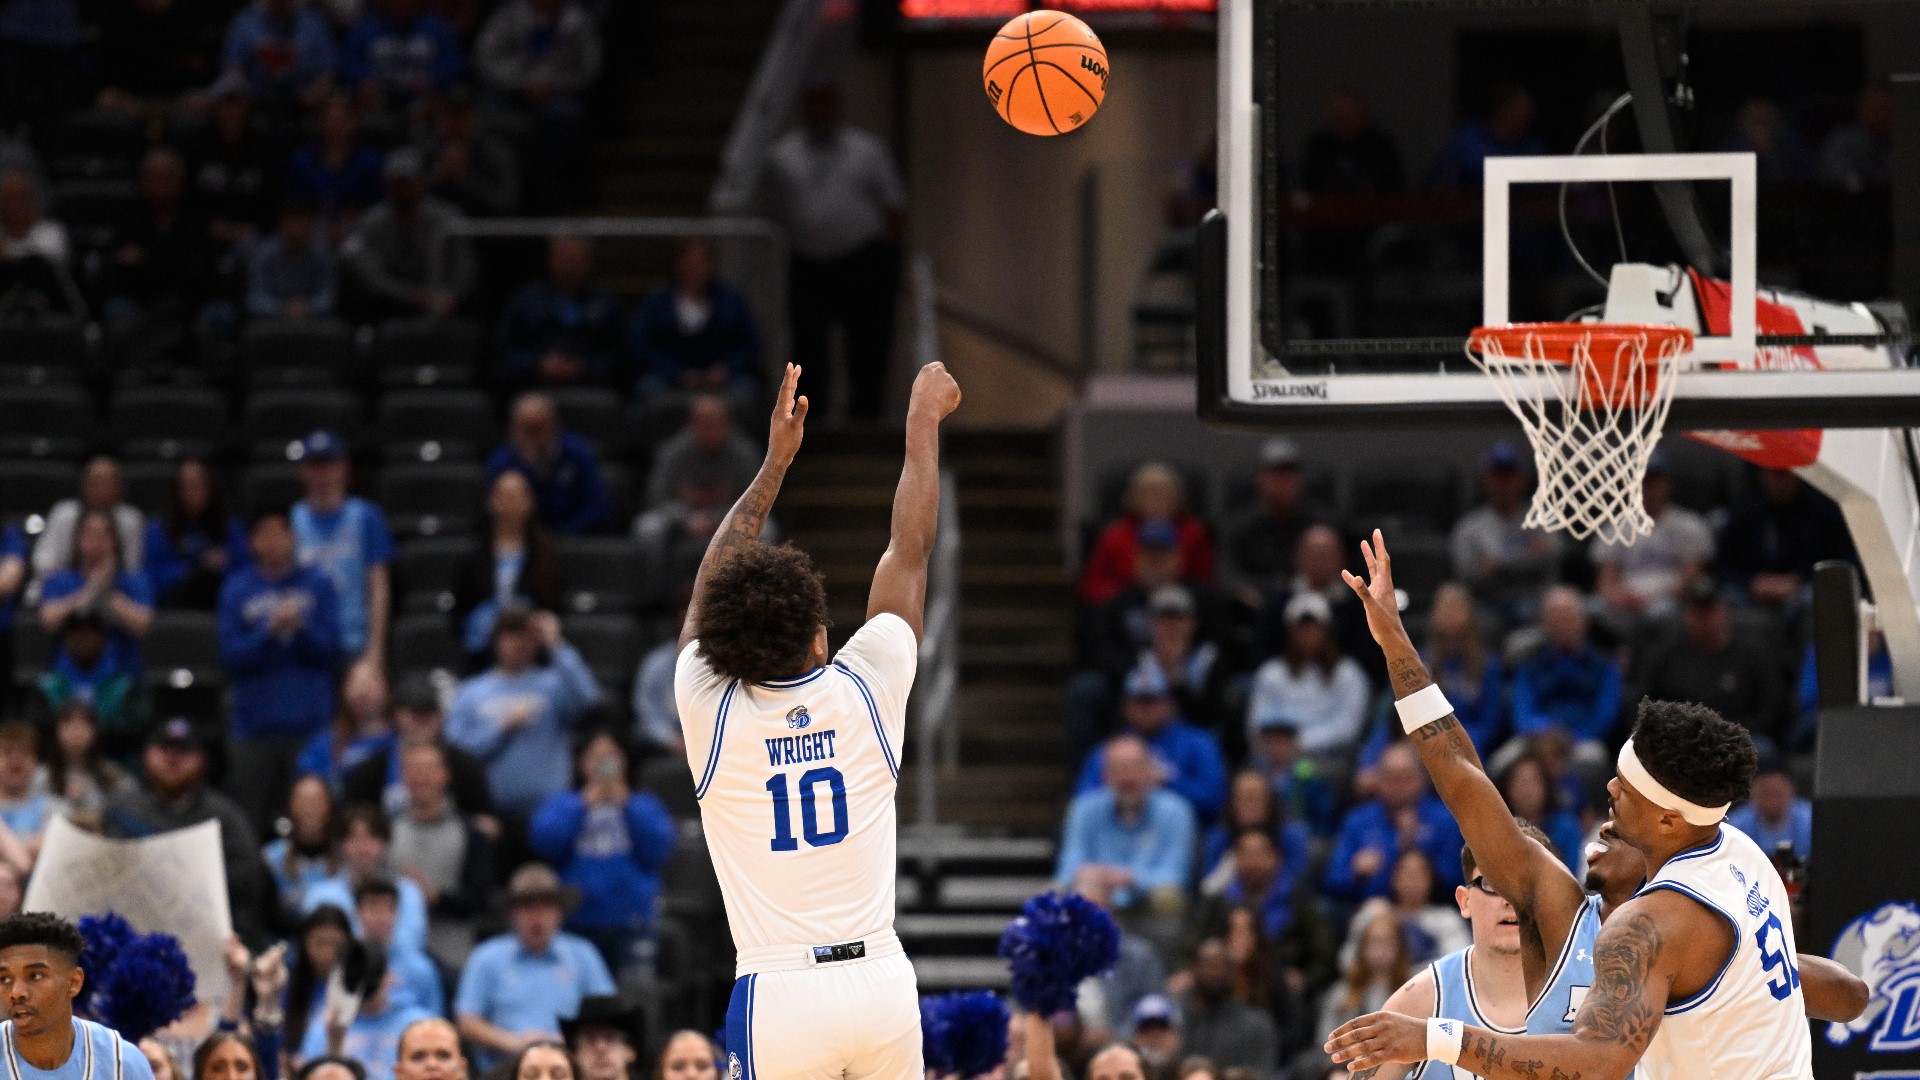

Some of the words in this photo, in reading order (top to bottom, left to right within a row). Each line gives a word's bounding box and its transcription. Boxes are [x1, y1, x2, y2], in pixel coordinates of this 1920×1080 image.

[1252, 382, 1328, 399] SPALDING
[765, 729, 836, 767] WRIGHT
[765, 766, 849, 851] 10
